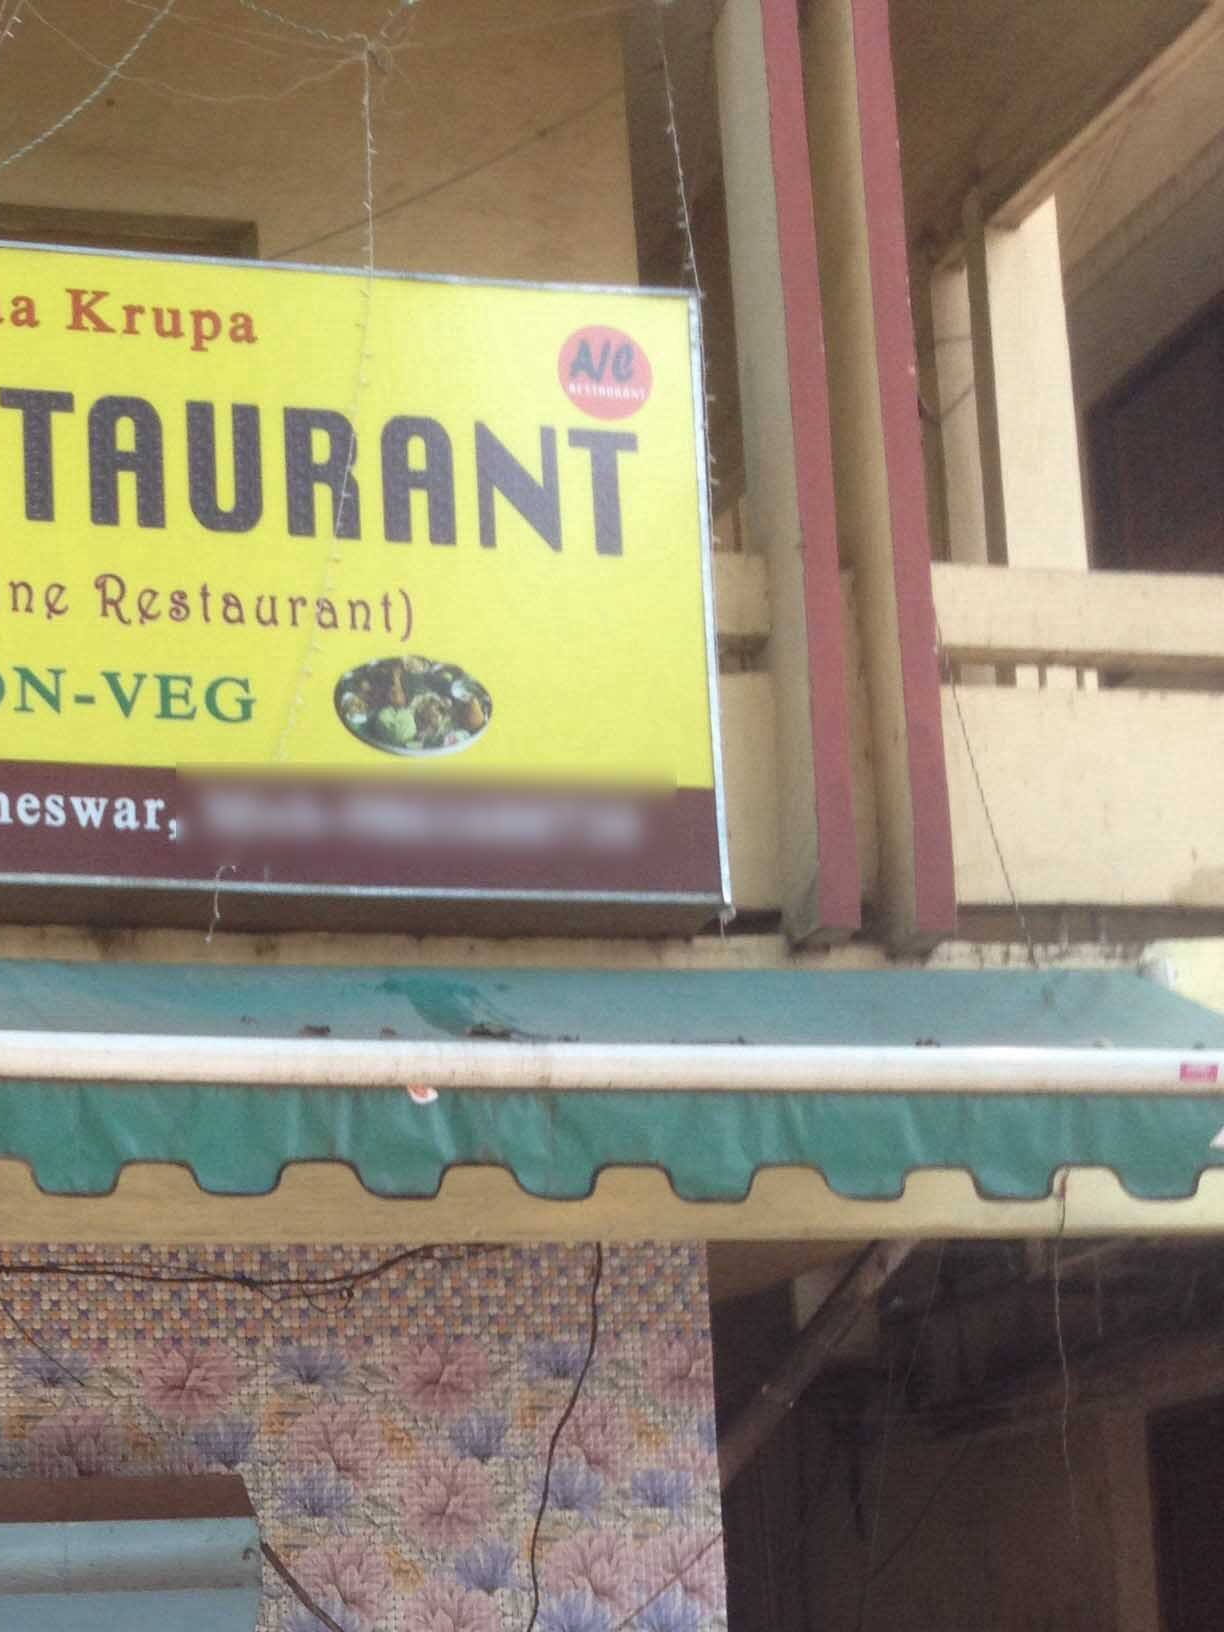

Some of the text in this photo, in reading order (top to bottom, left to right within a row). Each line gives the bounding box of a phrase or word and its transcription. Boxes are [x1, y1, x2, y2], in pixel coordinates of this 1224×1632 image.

[68, 289, 258, 351] Krupa
[568, 339, 633, 383] A/C
[93, 573, 415, 643] Restaurant)
